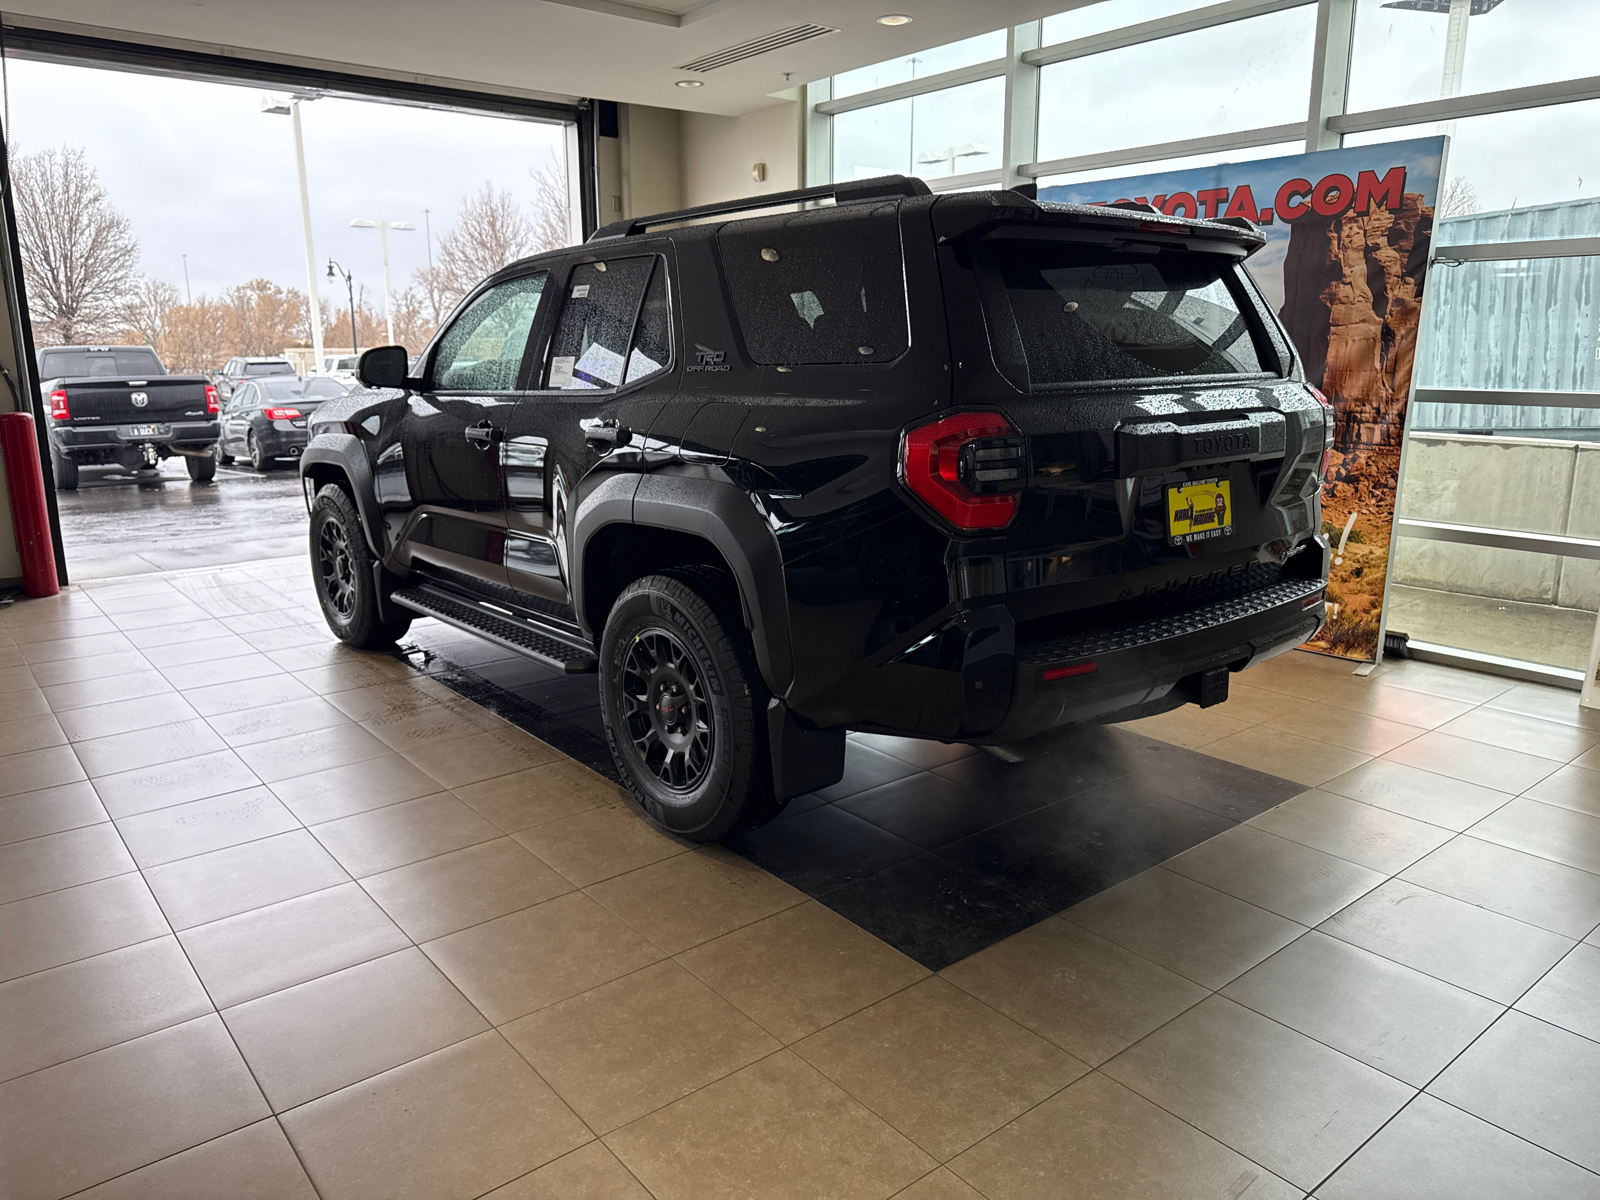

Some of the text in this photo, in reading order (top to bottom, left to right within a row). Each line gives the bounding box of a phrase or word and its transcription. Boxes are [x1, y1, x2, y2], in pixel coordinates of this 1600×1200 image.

[1087, 166, 1406, 226] YOTA.COM
[695, 350, 726, 365] TRD
[704, 364, 731, 372] ROAD
[1193, 432, 1251, 455] TOYOTA
[1185, 534, 1193, 542] WE
[1193, 532, 1205, 540] MAKE
[1210, 529, 1221, 537] EASY
[673, 612, 721, 692] MICHELIN
